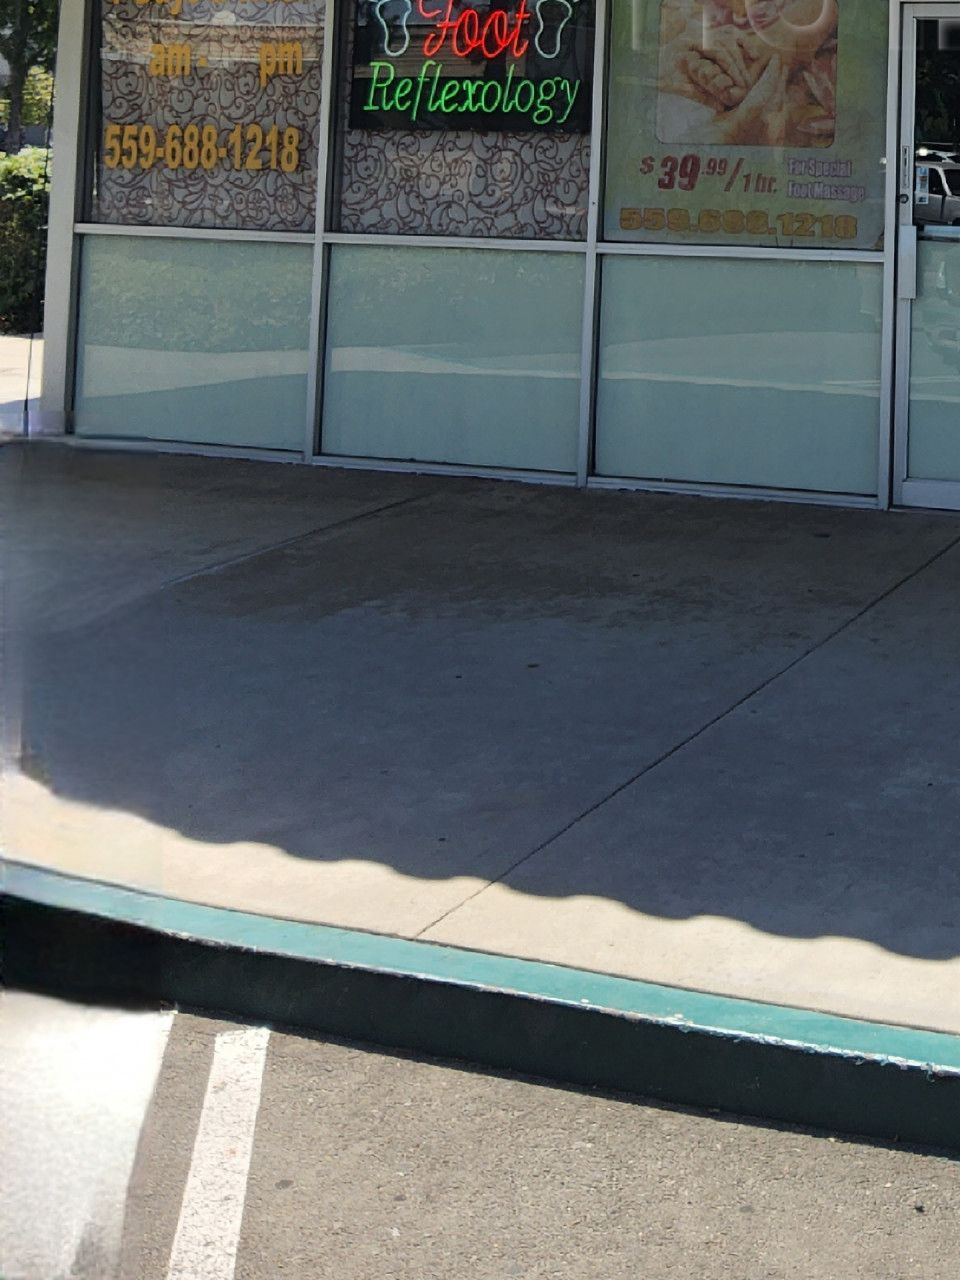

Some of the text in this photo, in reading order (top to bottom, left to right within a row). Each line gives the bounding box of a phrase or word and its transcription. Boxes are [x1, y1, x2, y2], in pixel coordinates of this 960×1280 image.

[149, 42, 191, 77] am
[260, 40, 304, 87] pm
[363, 59, 581, 125] Reflexology
[104, 124, 300, 173] 559-688-1218
